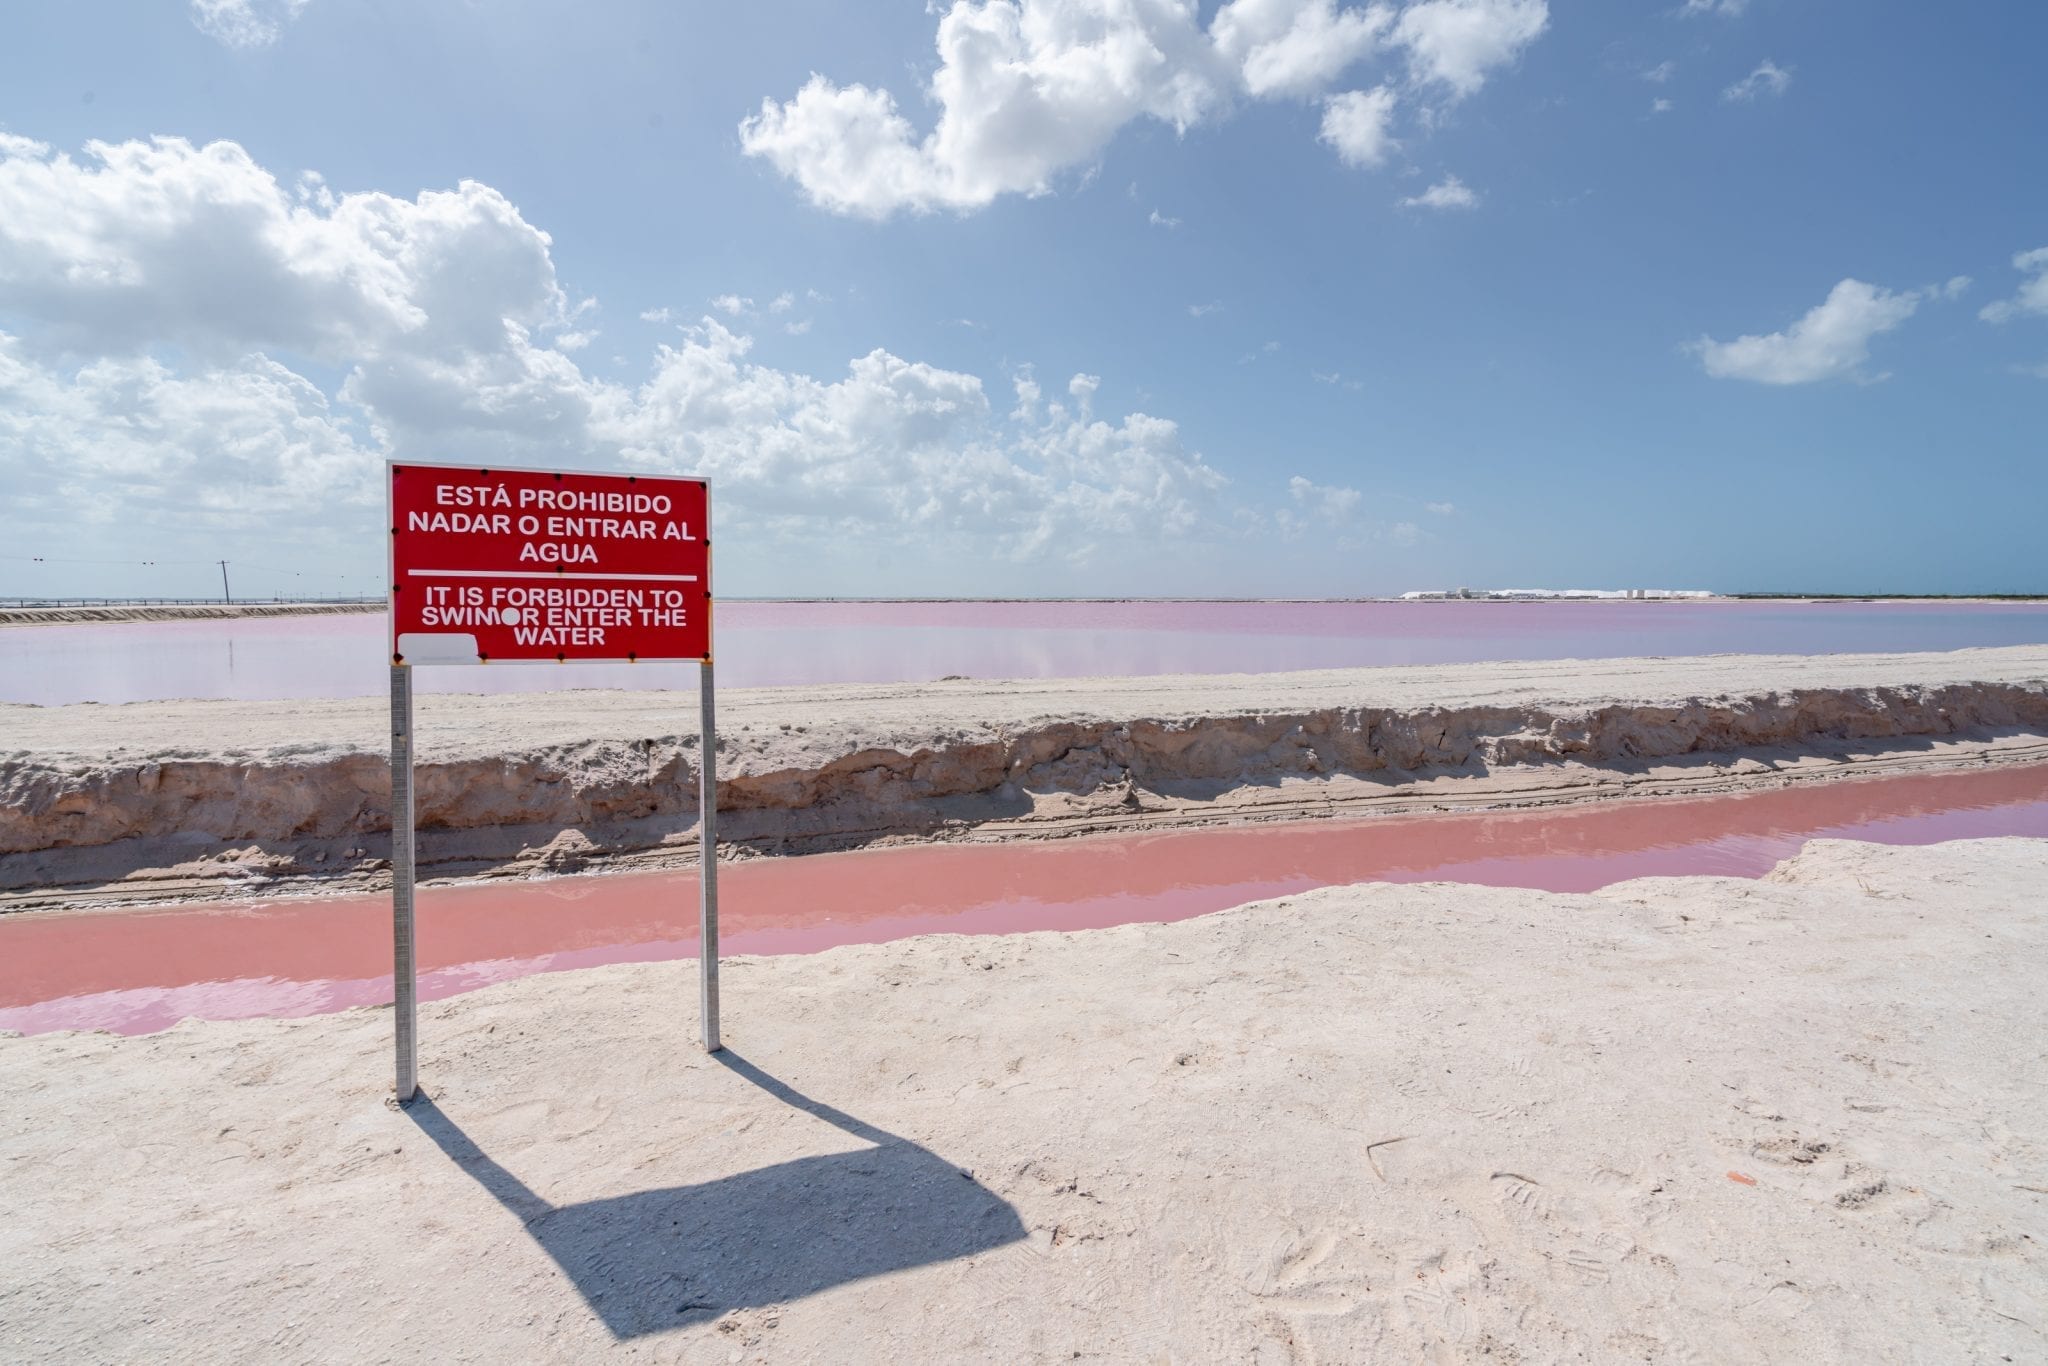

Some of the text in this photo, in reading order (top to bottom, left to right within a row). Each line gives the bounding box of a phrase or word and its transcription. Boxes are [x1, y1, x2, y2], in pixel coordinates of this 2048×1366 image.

[436, 483, 672, 515] ESTÁ PROHIBIDO
[408, 511, 697, 541] NADAR O ENTRAR AL
[519, 542, 599, 564] AGUA
[426, 586, 684, 608] IT IS FORBIDDEN TO
[547, 607, 632, 627] ENTER
[637, 608, 687, 627] THE
[513, 627, 605, 646] WATER
